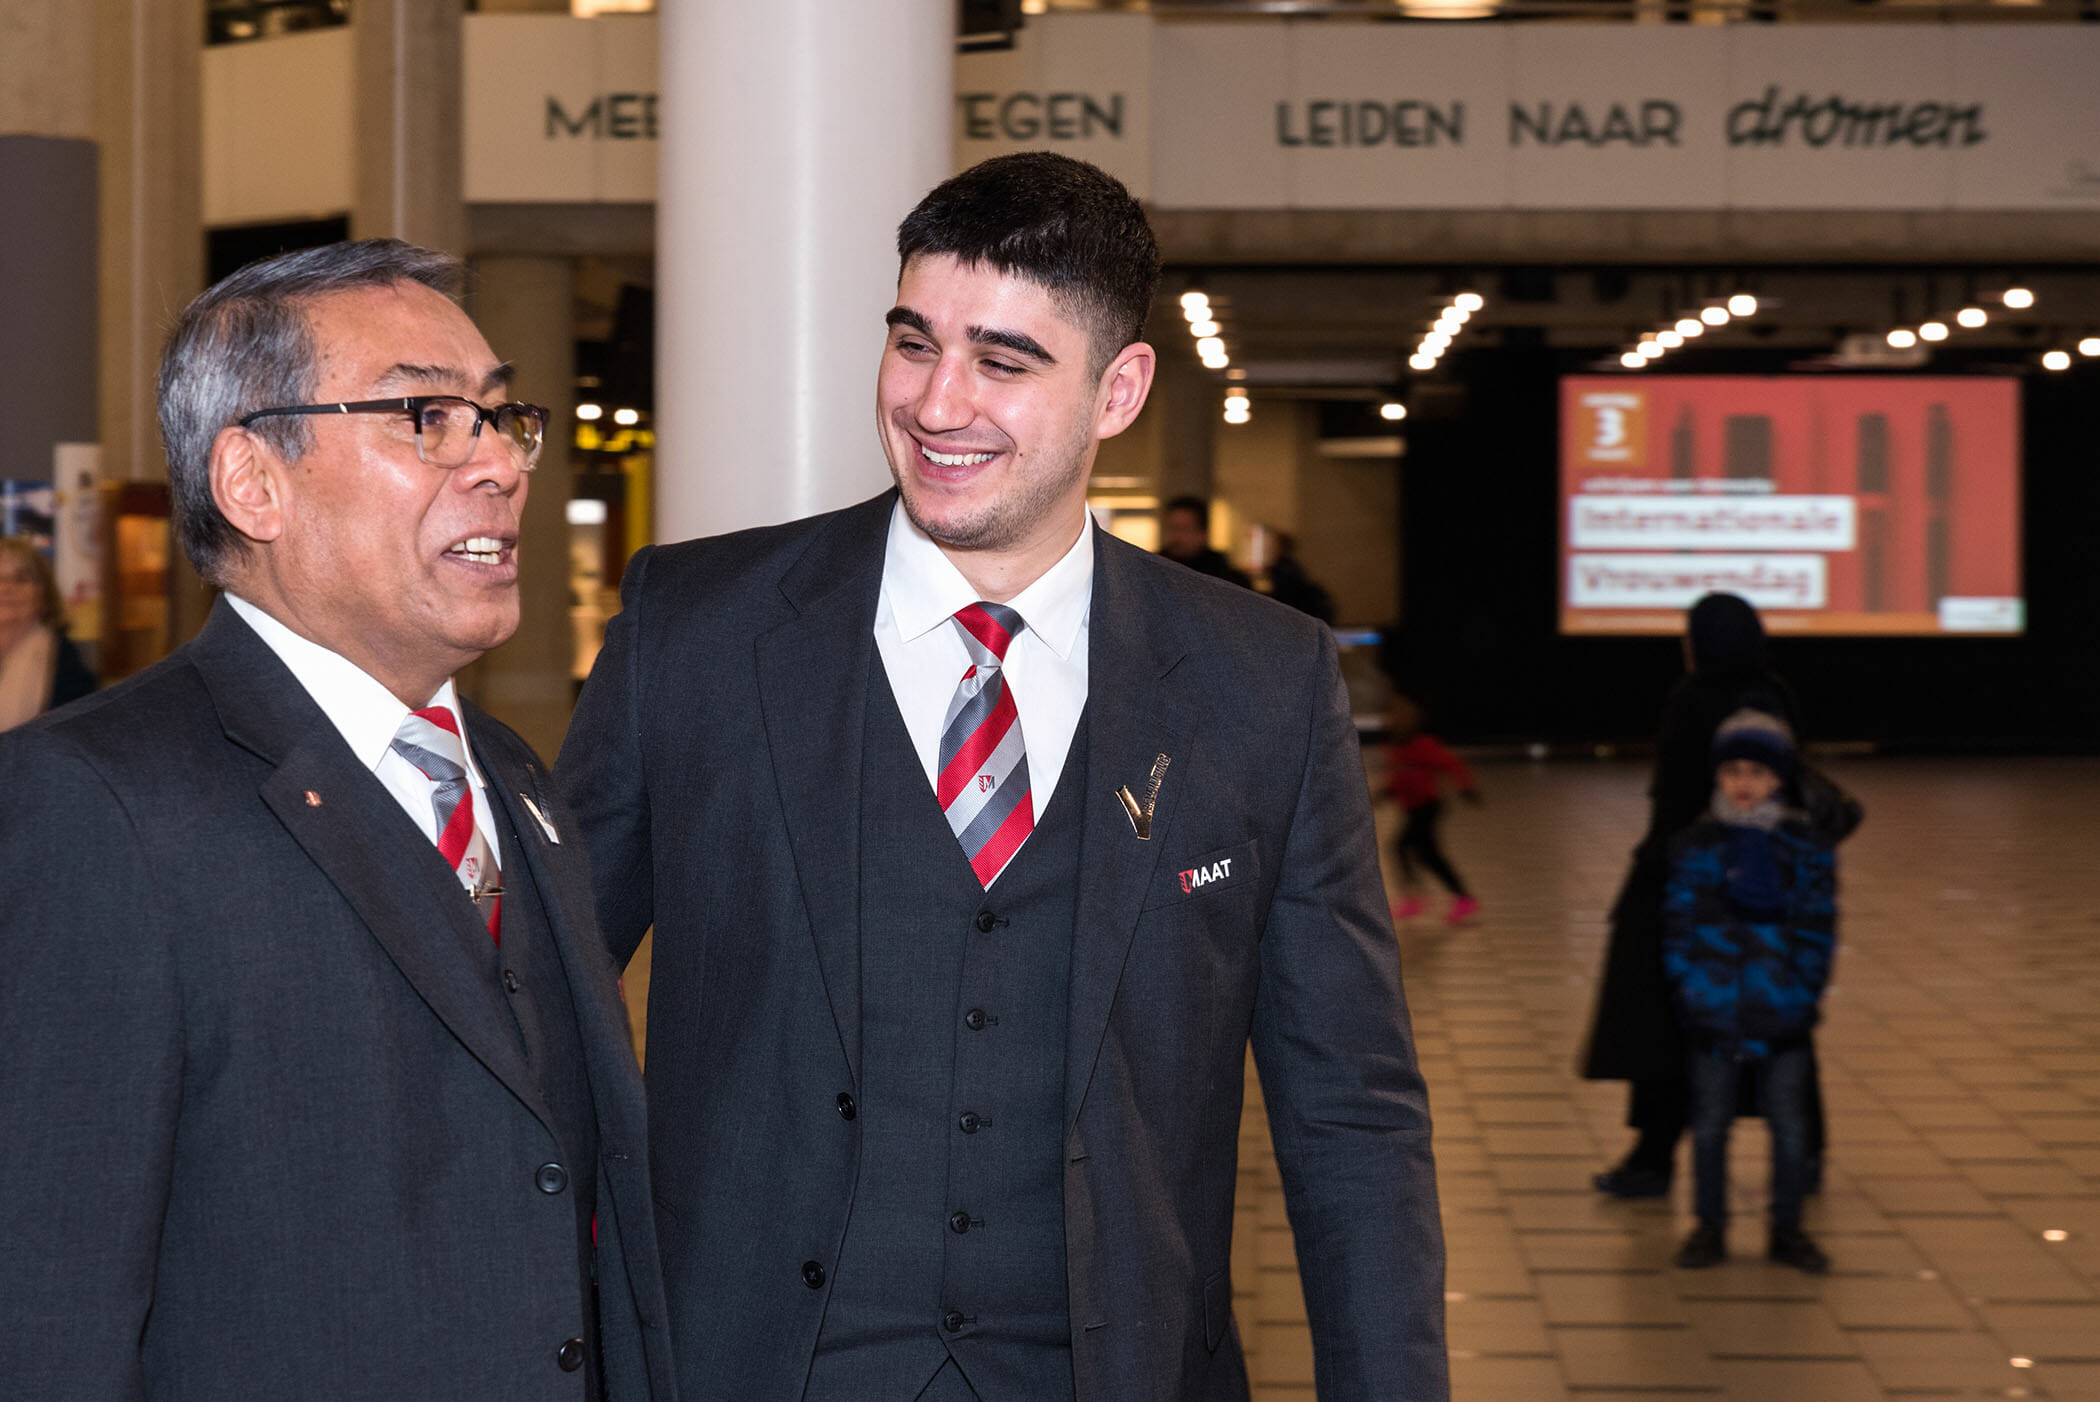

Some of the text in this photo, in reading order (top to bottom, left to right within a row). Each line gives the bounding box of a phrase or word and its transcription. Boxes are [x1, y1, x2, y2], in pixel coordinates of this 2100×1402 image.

[957, 92, 1123, 141] EGEN
[1275, 98, 1464, 147] LEIDEN
[1508, 98, 1682, 147] NAAR
[1726, 85, 1987, 148] dromen
[1596, 407, 1624, 446] 3
[1582, 504, 1839, 533] Internationale
